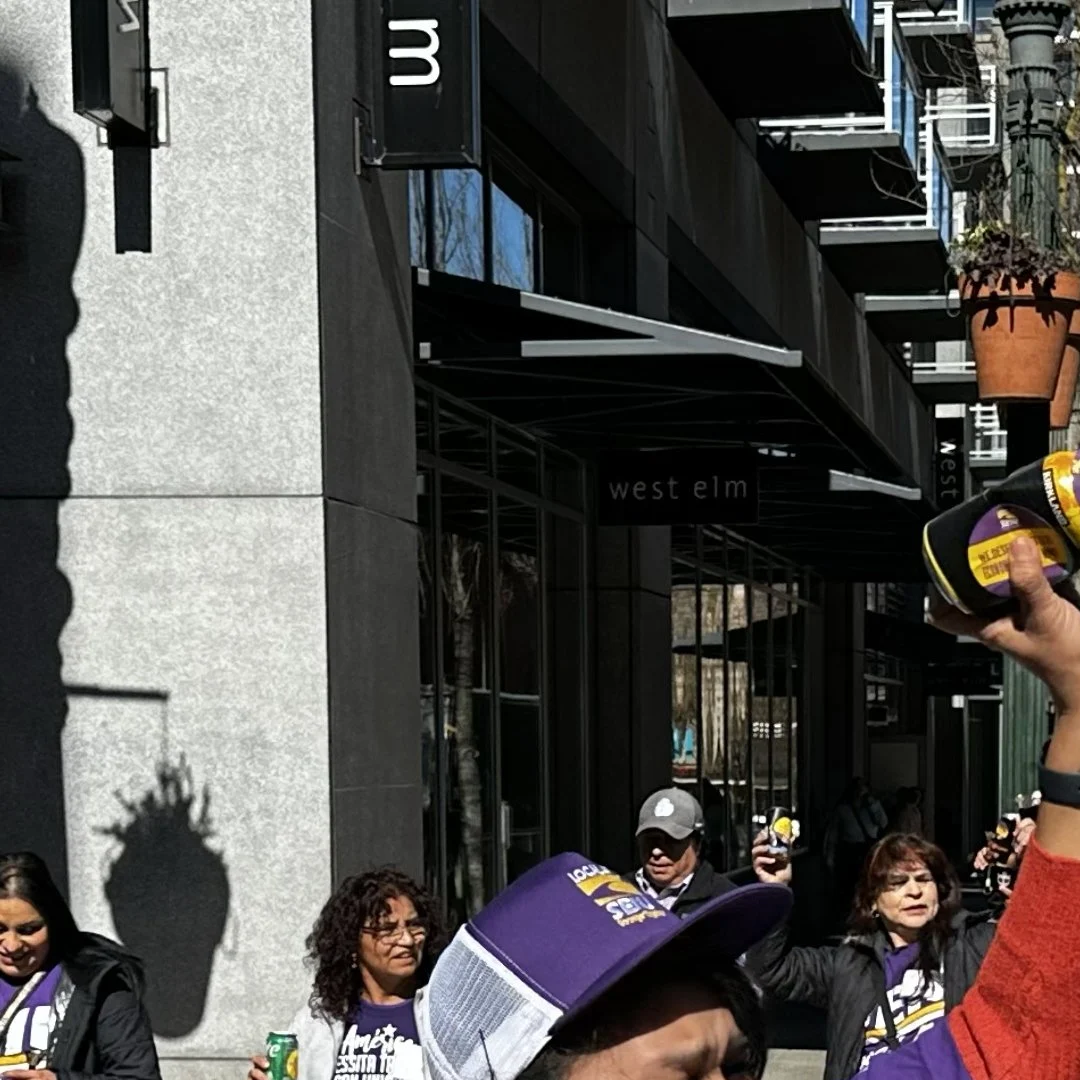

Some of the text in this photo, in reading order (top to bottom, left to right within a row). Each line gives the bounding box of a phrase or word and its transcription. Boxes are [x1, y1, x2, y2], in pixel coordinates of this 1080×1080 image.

[607, 474, 748, 501] west elm
[940, 438, 962, 500] west
